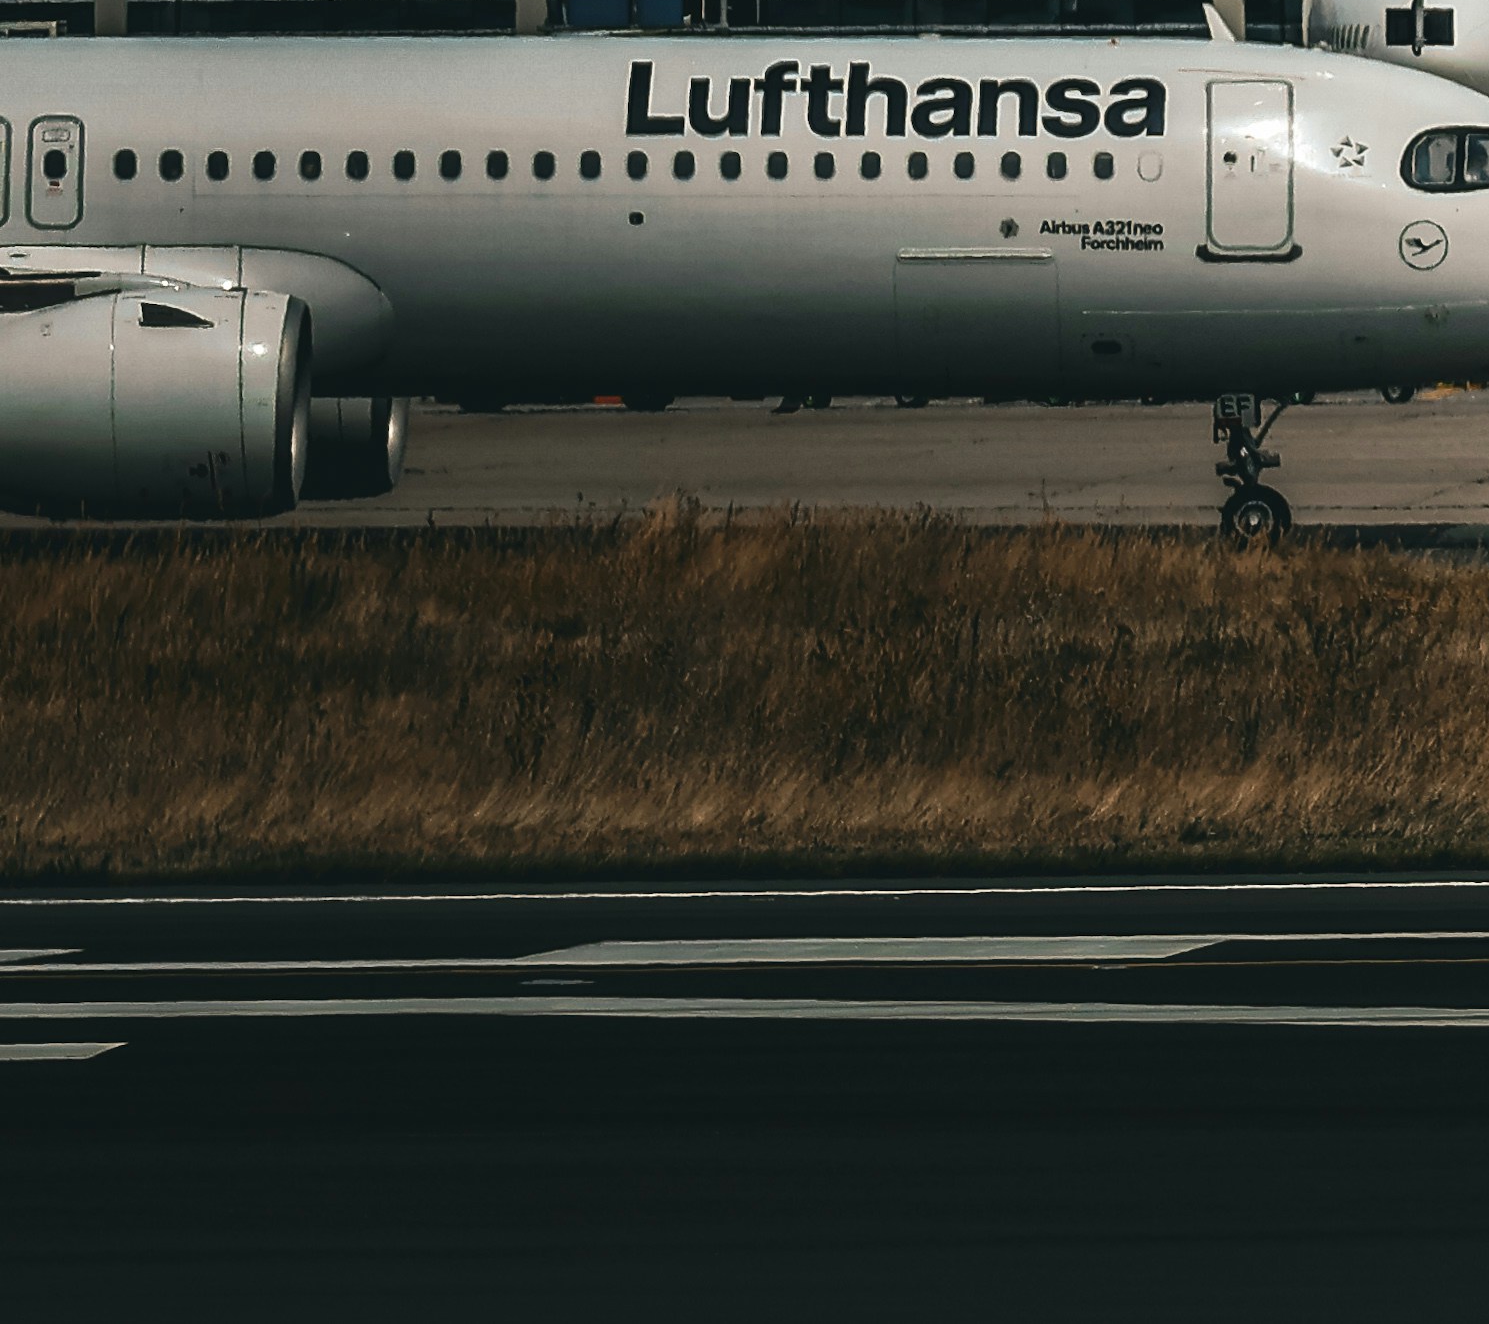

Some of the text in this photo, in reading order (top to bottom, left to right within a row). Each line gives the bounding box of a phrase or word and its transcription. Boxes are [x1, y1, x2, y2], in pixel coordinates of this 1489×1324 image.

[625, 60, 1167, 138] Lufthansa
[1040, 220, 1090, 234] Airbus
[1080, 235, 1164, 251] Forchheim
